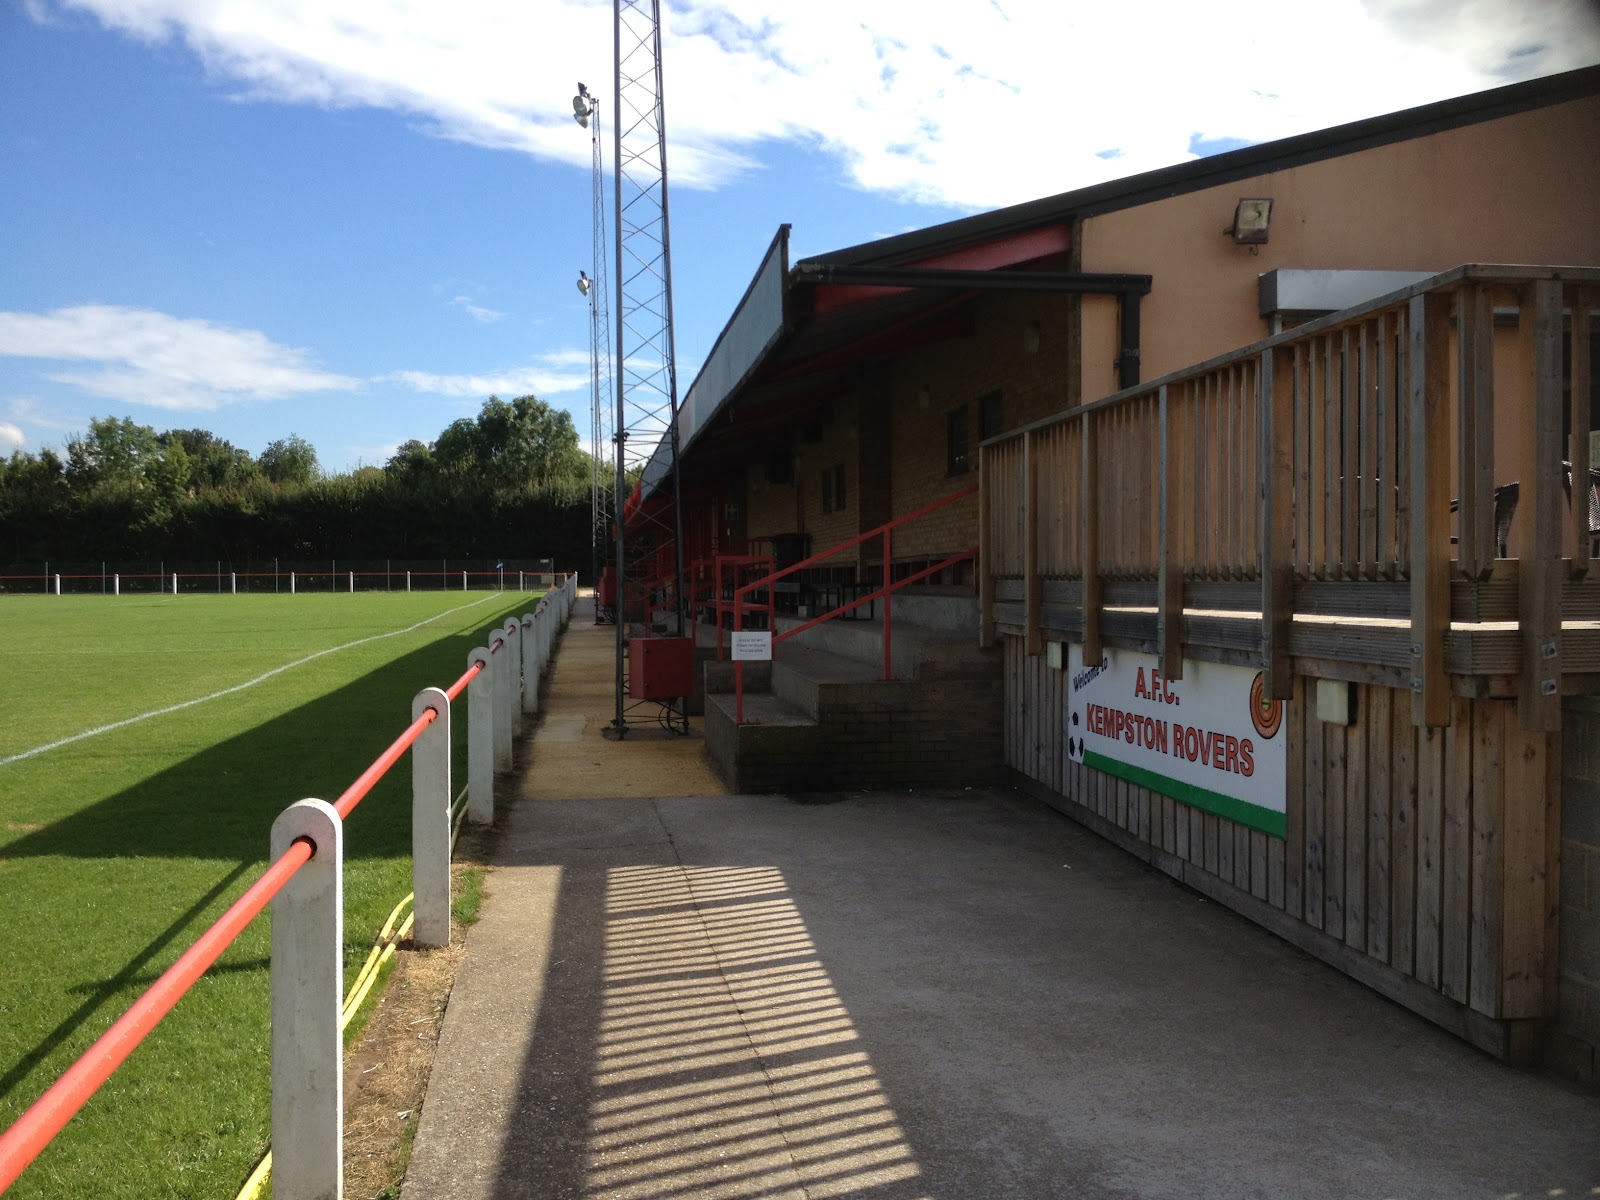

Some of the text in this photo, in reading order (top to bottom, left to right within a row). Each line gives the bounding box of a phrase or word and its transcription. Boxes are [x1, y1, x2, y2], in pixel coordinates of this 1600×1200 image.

[1073, 666, 1100, 693] Welcome
[1086, 703, 1255, 778] KEMPSTON ROVERS
